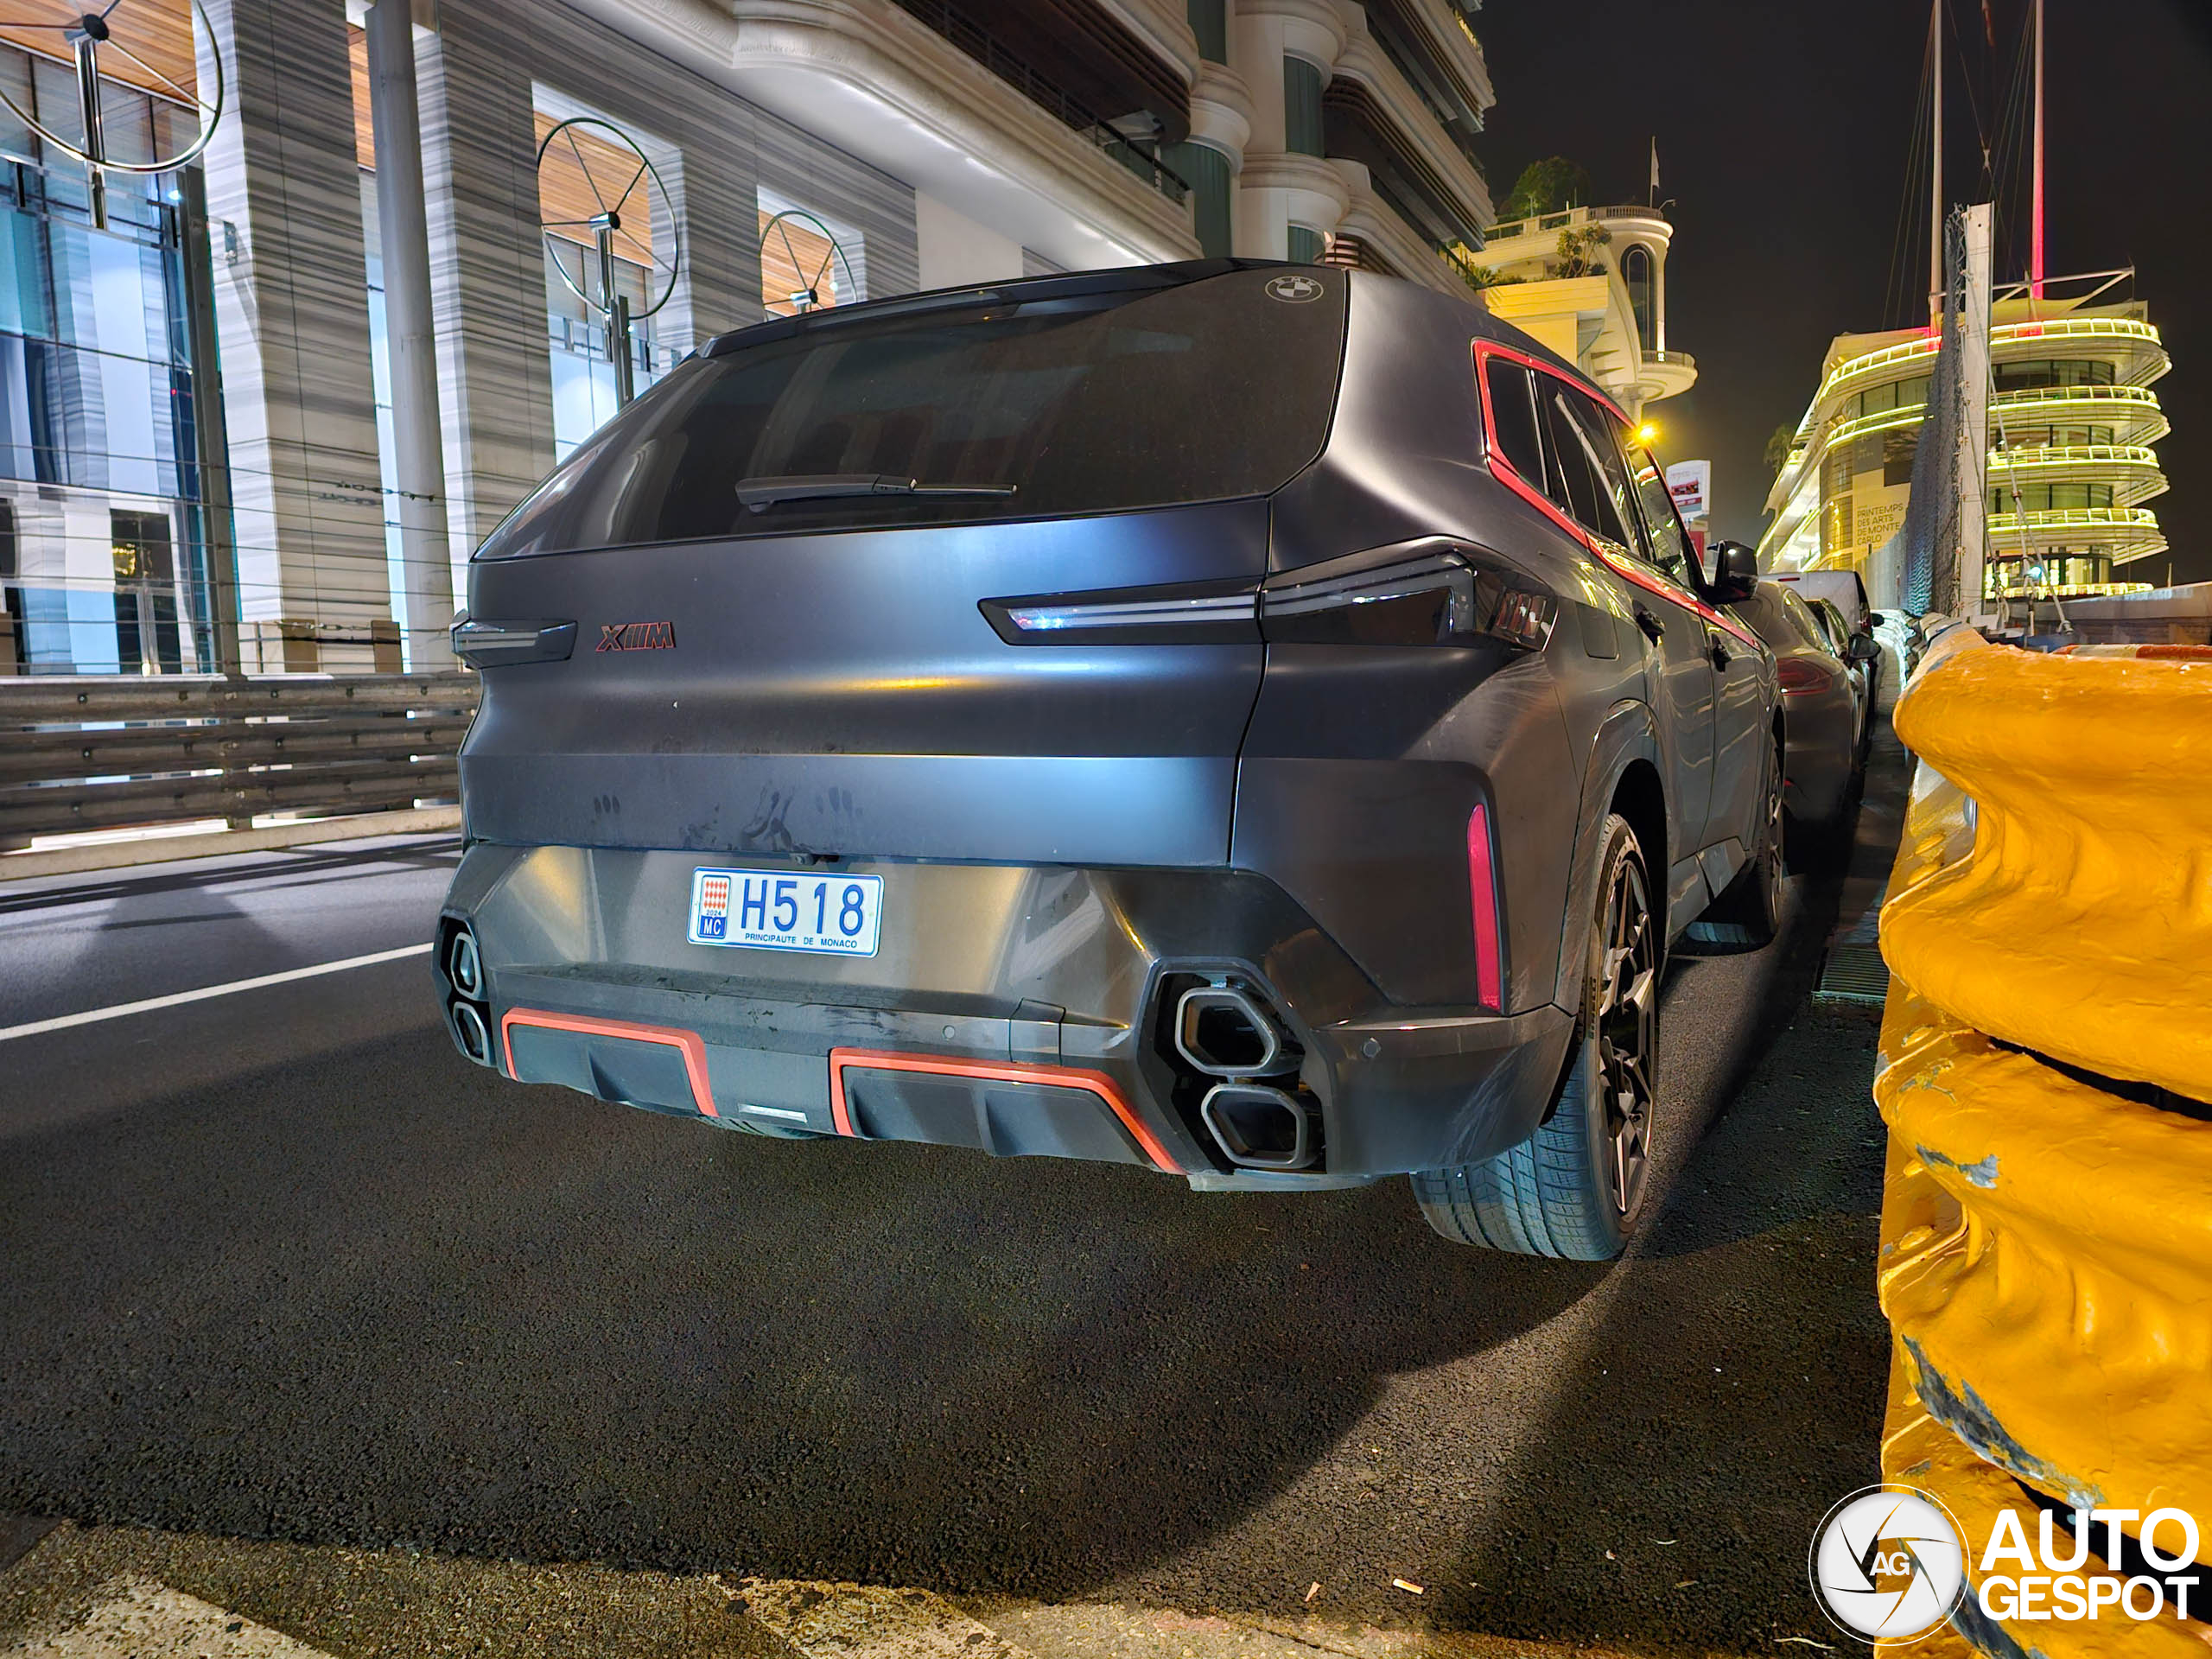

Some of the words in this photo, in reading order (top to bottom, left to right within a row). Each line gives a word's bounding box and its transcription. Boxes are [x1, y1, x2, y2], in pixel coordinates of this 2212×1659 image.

[1857, 503, 1904, 518] PRINTEMPS
[1858, 518, 1870, 527] DES
[1872, 514, 1894, 524] ARTS
[1858, 528, 1867, 537] DE
[1868, 521, 1901, 533] MONTE
[1857, 534, 1882, 545] CARLO
[741, 879, 865, 936] H518
[703, 918, 722, 935] MC
[745, 933, 796, 944] PRINCIPAUTE
[803, 937, 814, 945] DE
[820, 938, 858, 949] MONACO
